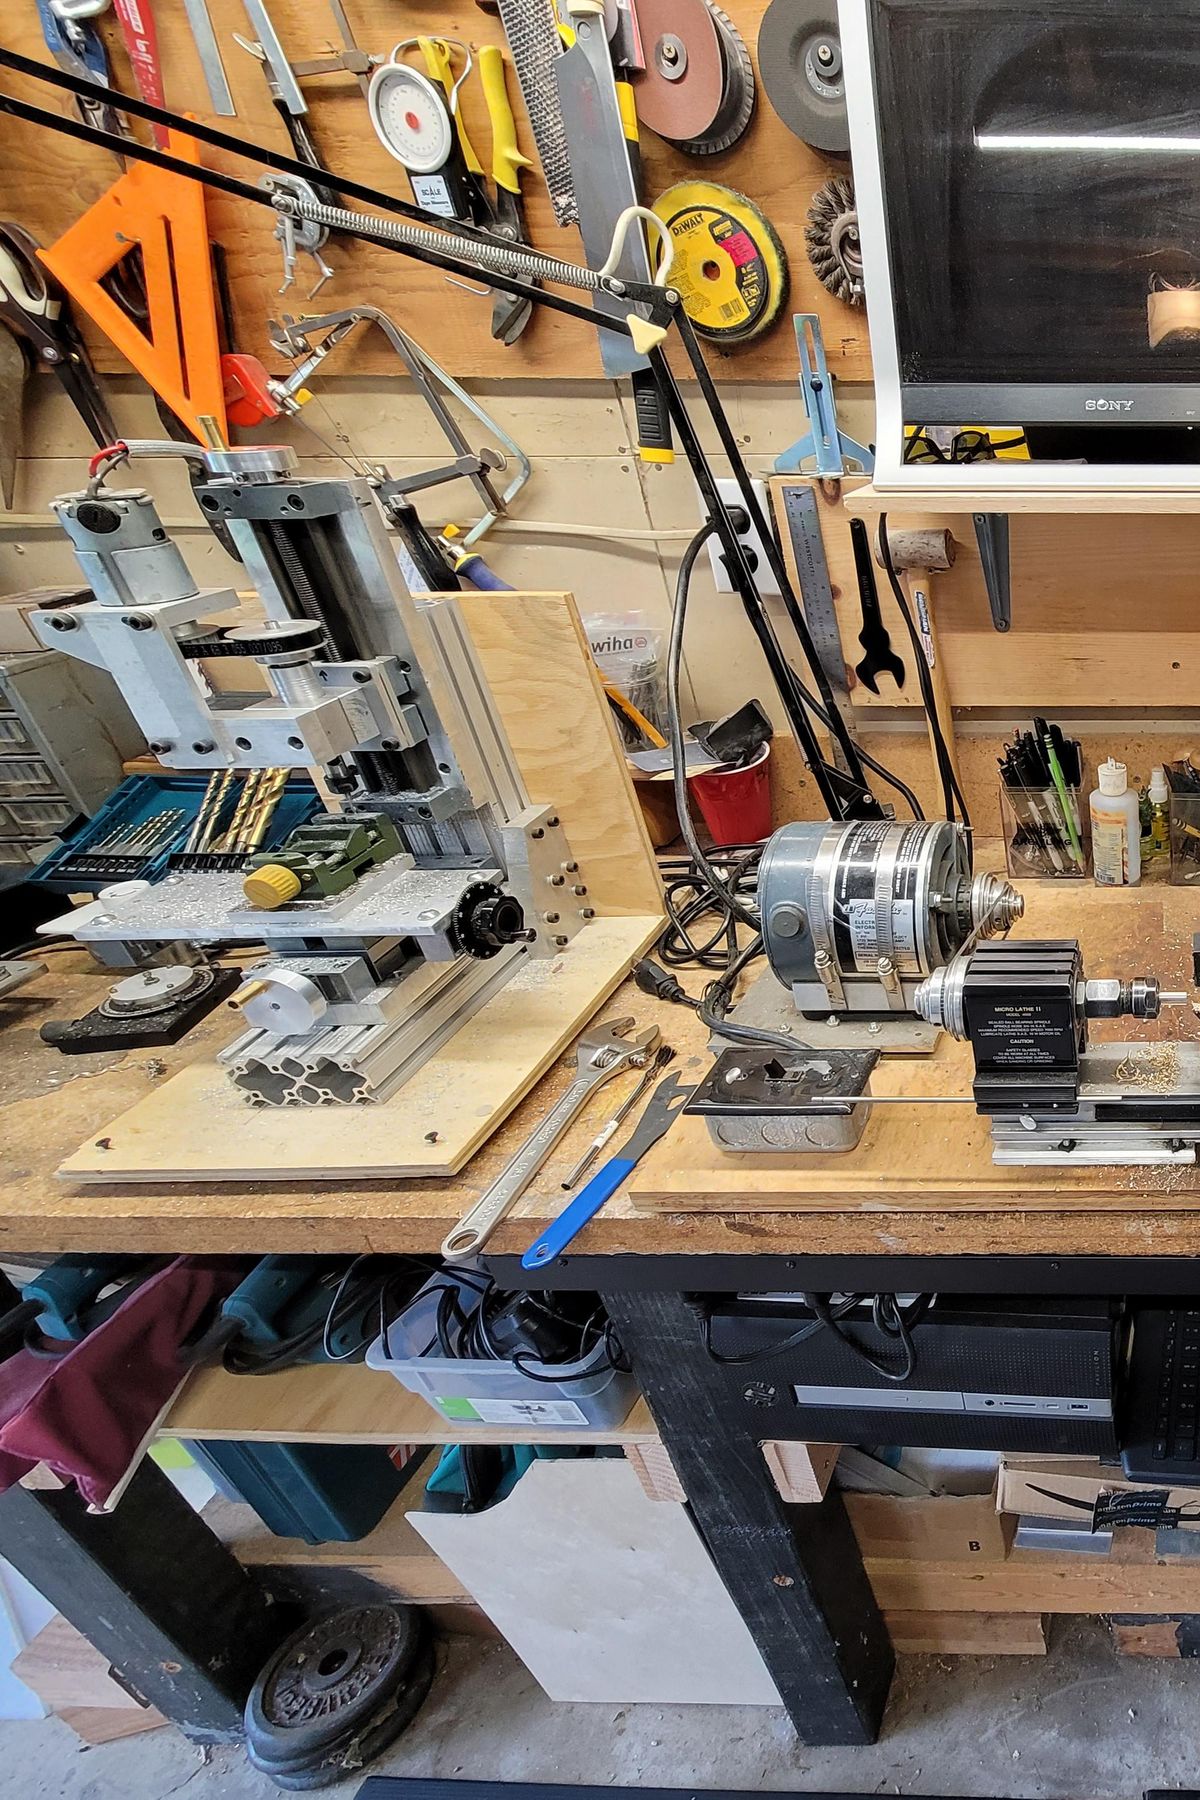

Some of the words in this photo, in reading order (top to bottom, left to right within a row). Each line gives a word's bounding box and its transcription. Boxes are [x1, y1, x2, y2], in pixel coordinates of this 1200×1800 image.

[1085, 399, 1134, 411] SONY
[592, 636, 633, 653] wiha
[969, 1541, 981, 1551] B
